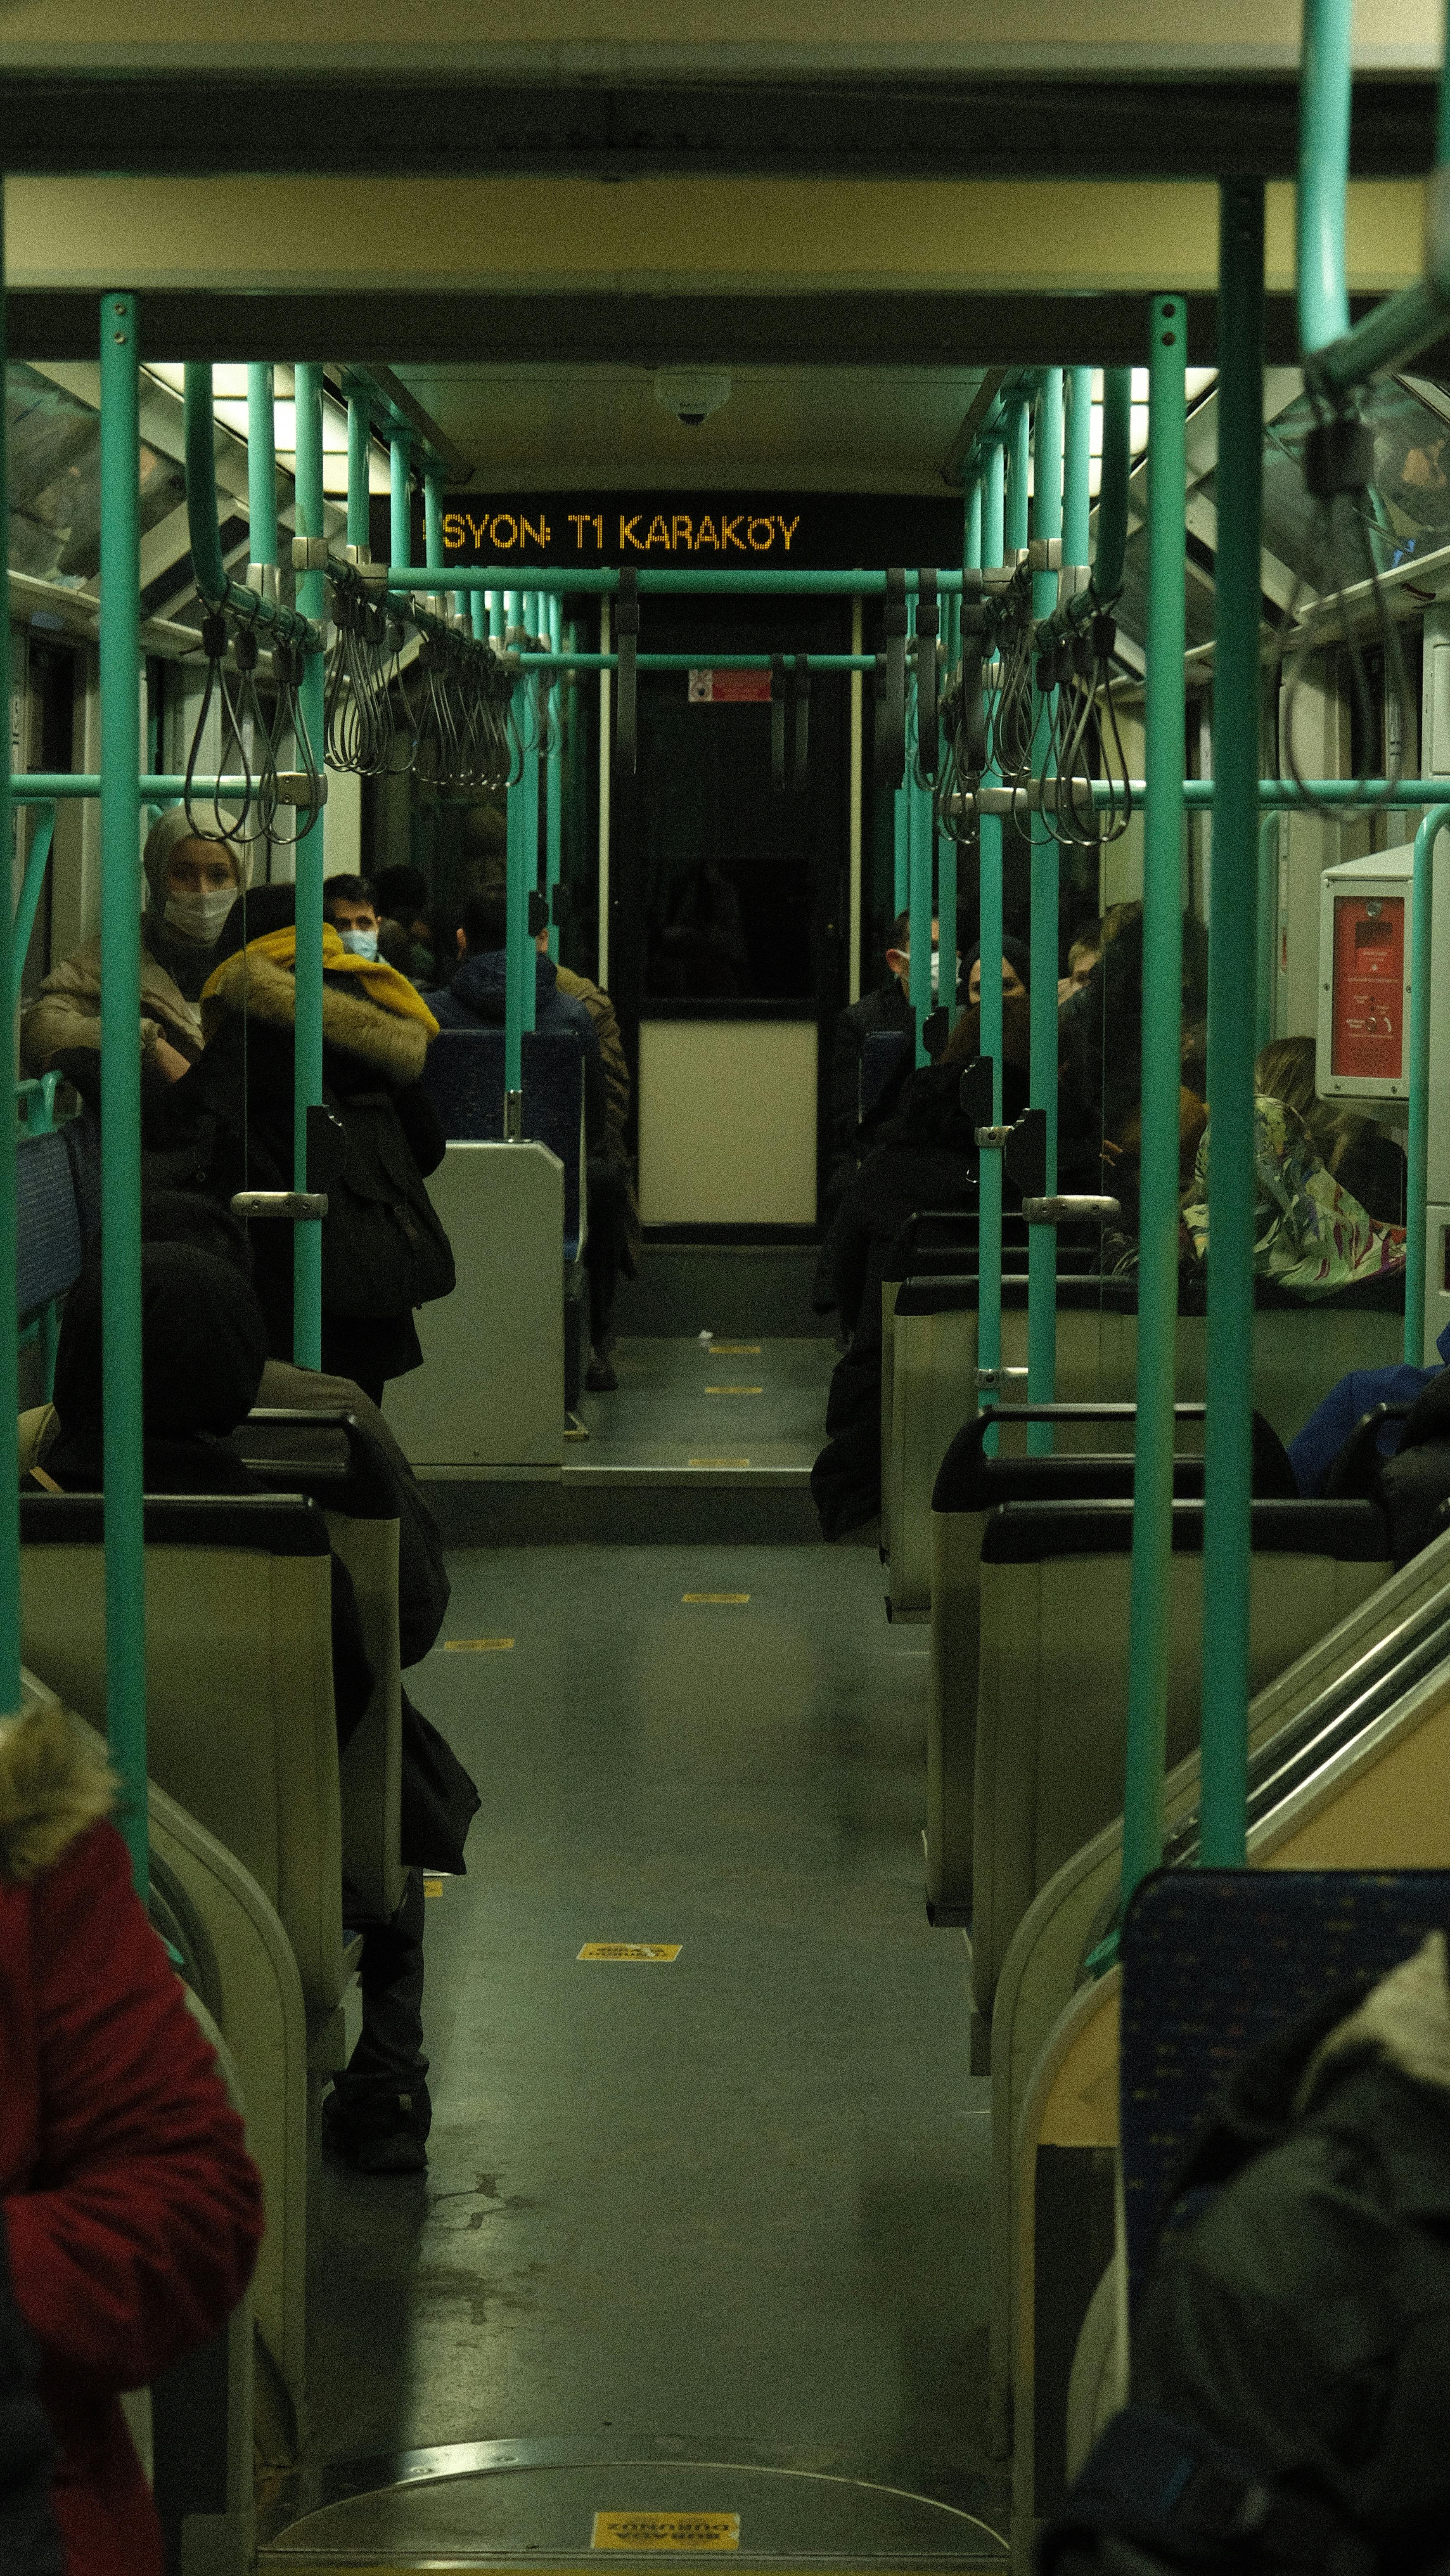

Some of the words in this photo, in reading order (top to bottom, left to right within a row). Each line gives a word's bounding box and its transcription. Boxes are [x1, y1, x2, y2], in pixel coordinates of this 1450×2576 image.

[422, 514, 550, 548] SYON:
[568, 514, 602, 548] T1
[620, 515, 799, 549] KARAKÖY
